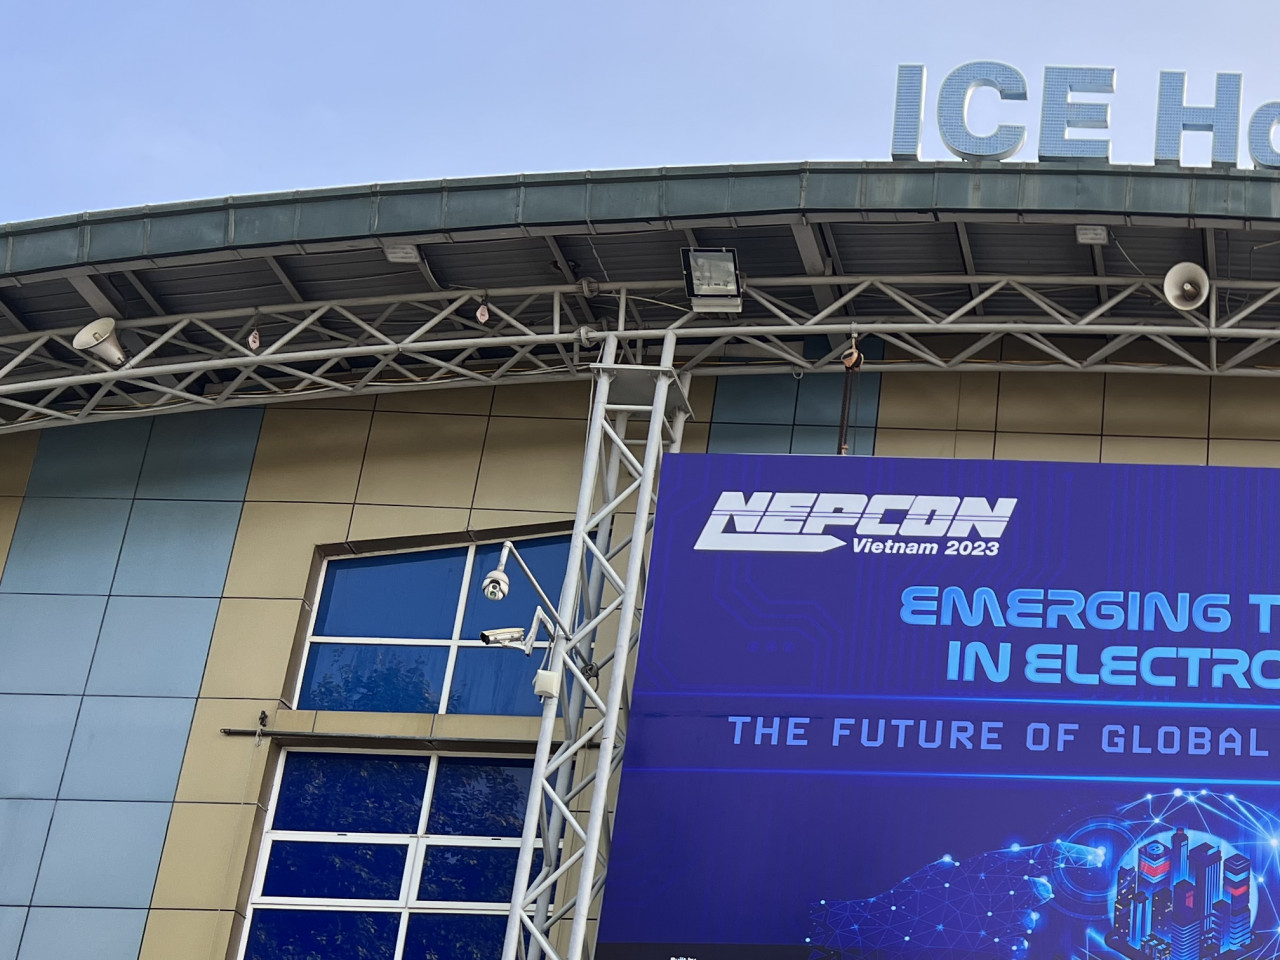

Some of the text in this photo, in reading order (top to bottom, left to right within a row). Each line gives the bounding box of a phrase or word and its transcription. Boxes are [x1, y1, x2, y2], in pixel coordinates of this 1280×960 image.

[891, 60, 1116, 162] ICE
[694, 491, 1017, 552] NEPCON
[852, 537, 999, 556] Vietnam 2023
[900, 585, 1232, 633] EMERGING
[947, 640, 1011, 683] IN
[728, 715, 810, 747] THE
[832, 718, 1004, 751] FUTURE
[1026, 722, 1079, 752] OF
[1102, 724, 1269, 758] GLOBAL
